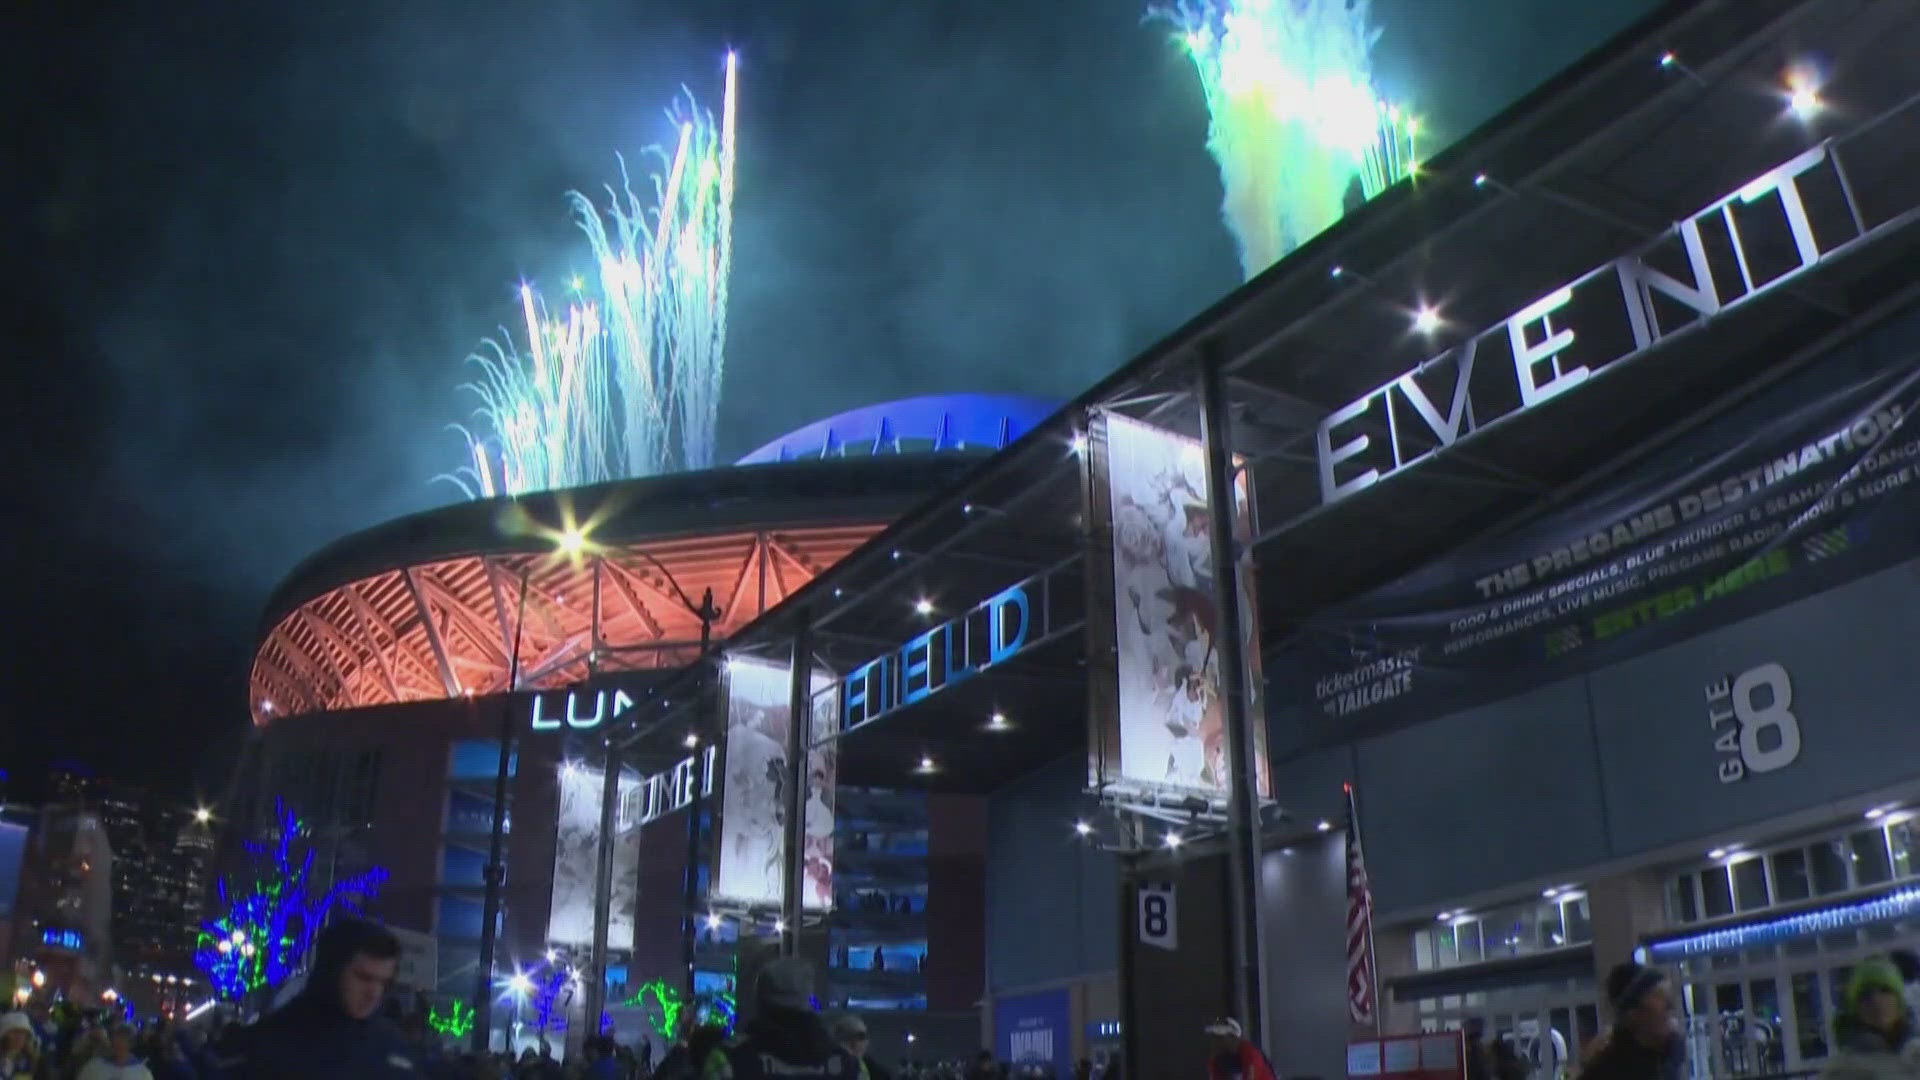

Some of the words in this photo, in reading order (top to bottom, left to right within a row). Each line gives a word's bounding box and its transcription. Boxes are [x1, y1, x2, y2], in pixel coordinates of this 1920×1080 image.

[1316, 136, 1827, 502] EVENT
[1450, 612, 1486, 633] FOOD
[1502, 590, 1545, 616] DRINK
[1626, 544, 1666, 570] BLUE
[1669, 513, 1745, 552] THUNDER
[1765, 464, 1861, 516] SEAHA
[1475, 562, 1532, 598] THE
[1531, 504, 1676, 579] PREGAME
[1677, 404, 1904, 521] DESTINATION
[1557, 593, 1592, 614] LIVE
[1648, 545, 1728, 581] PREGAME
[1858, 466, 1911, 500] MORE
[844, 587, 1029, 733] FIELD
[1316, 646, 1422, 700] ticketmaster
[1336, 669, 1413, 717] TAILGATE
[1732, 663, 1800, 773] 8
[1704, 676, 1744, 784] GATE
[1144, 894, 1168, 938] 8
